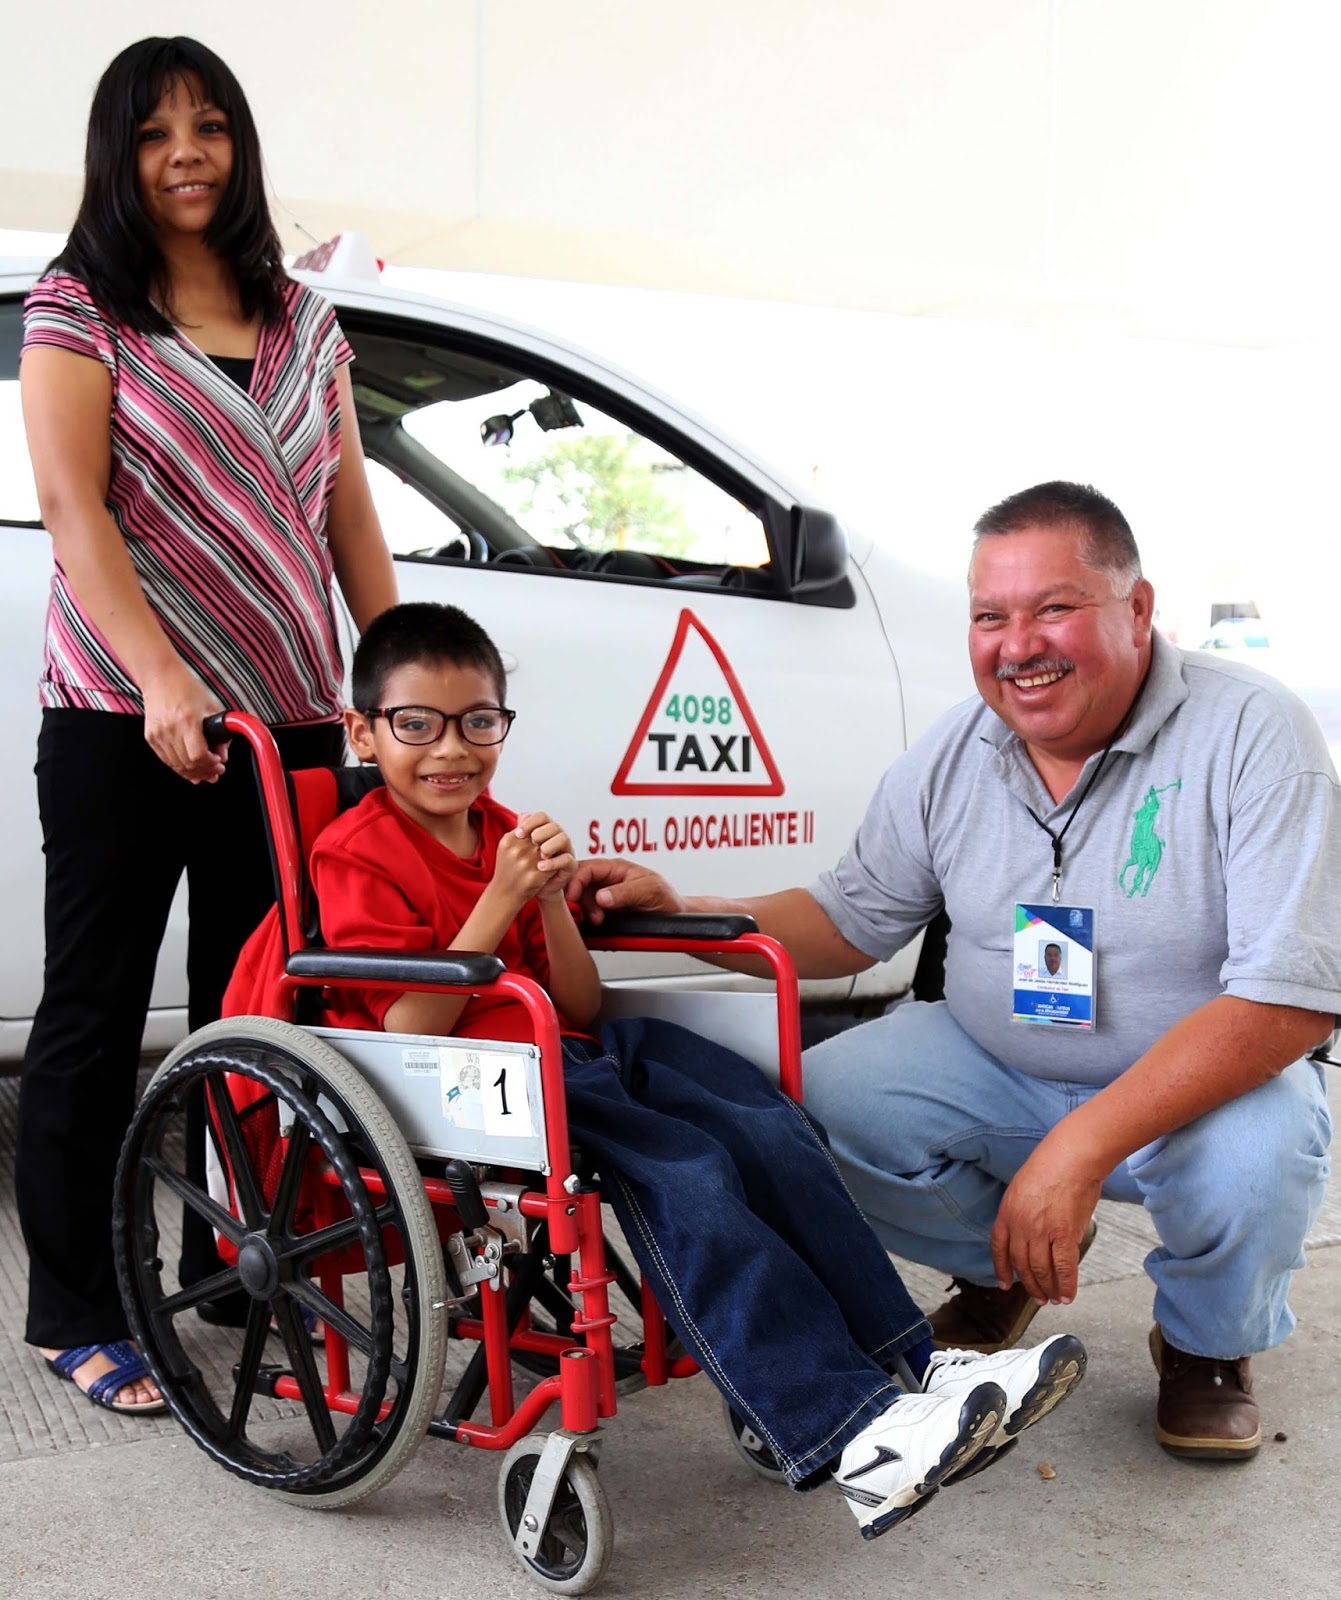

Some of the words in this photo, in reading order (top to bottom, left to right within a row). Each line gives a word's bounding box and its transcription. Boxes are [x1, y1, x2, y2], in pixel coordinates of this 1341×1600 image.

[665, 694, 733, 725] 4098
[648, 733, 752, 772] TAXI
[588, 820, 605, 854] S.
[613, 818, 657, 852] COL.
[664, 812, 798, 851] OJOCALIENTE
[493, 1068, 512, 1115] 1
